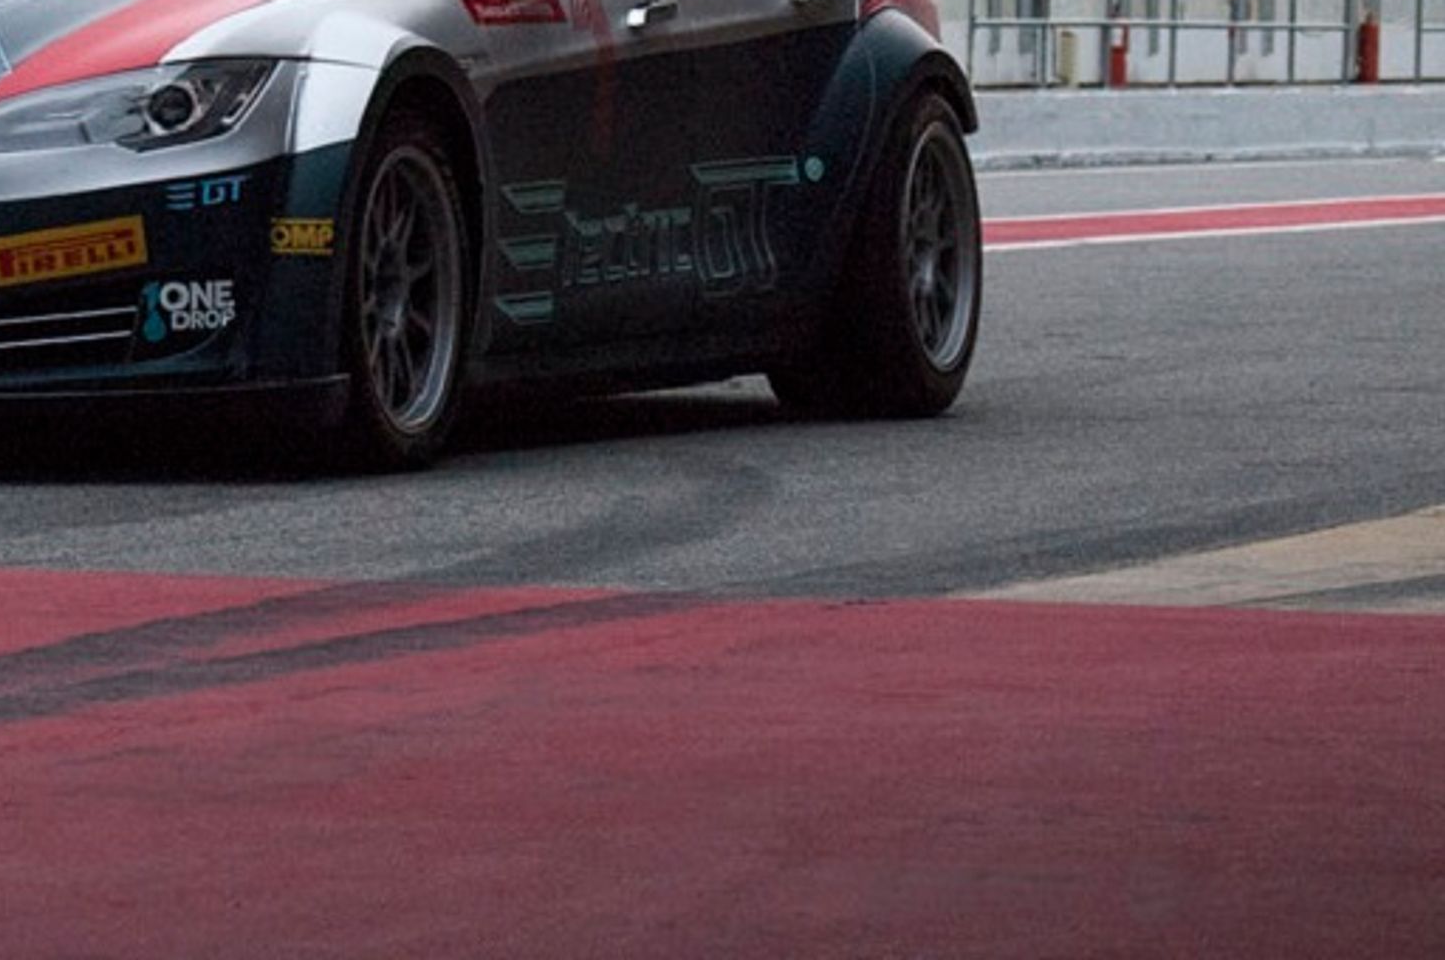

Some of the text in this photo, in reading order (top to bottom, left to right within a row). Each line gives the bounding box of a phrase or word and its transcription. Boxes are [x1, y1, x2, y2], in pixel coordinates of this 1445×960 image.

[270, 224, 334, 249] OMP
[160, 280, 234, 311] ONE
[171, 305, 236, 331] DROP
